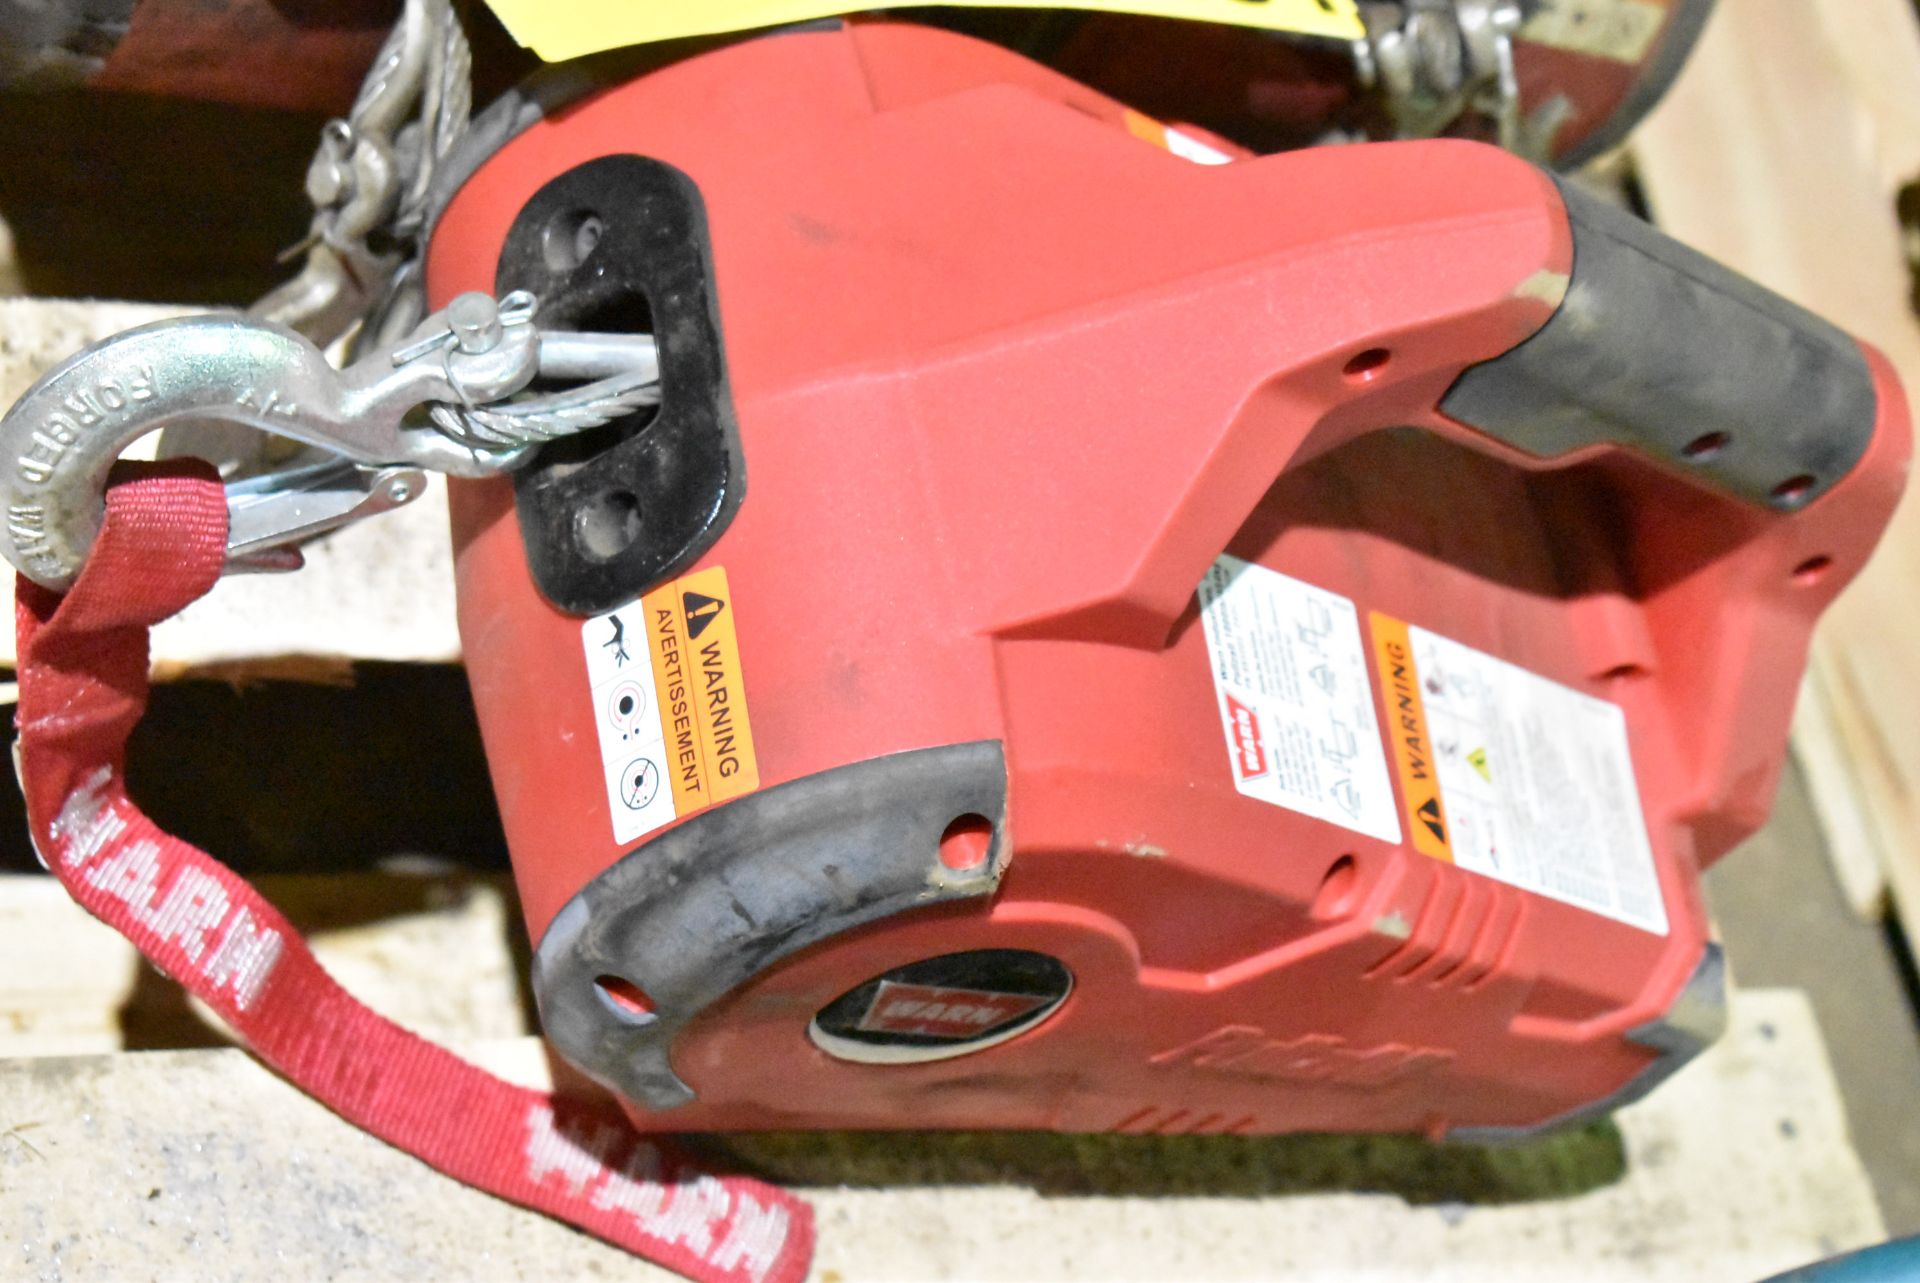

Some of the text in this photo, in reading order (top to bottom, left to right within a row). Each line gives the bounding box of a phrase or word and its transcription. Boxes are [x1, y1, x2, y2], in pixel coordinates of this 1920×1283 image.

[18, 364, 162, 484] FORGED
[656, 608, 700, 793] AVERTISSEMENT
[700, 640, 740, 778] WARNING
[1235, 707, 1260, 771] WARN
[1387, 641, 1427, 779] WARNING
[50, 763, 284, 1012] WARN
[881, 1000, 1006, 1025] WARN
[525, 1104, 791, 1283] WARN
